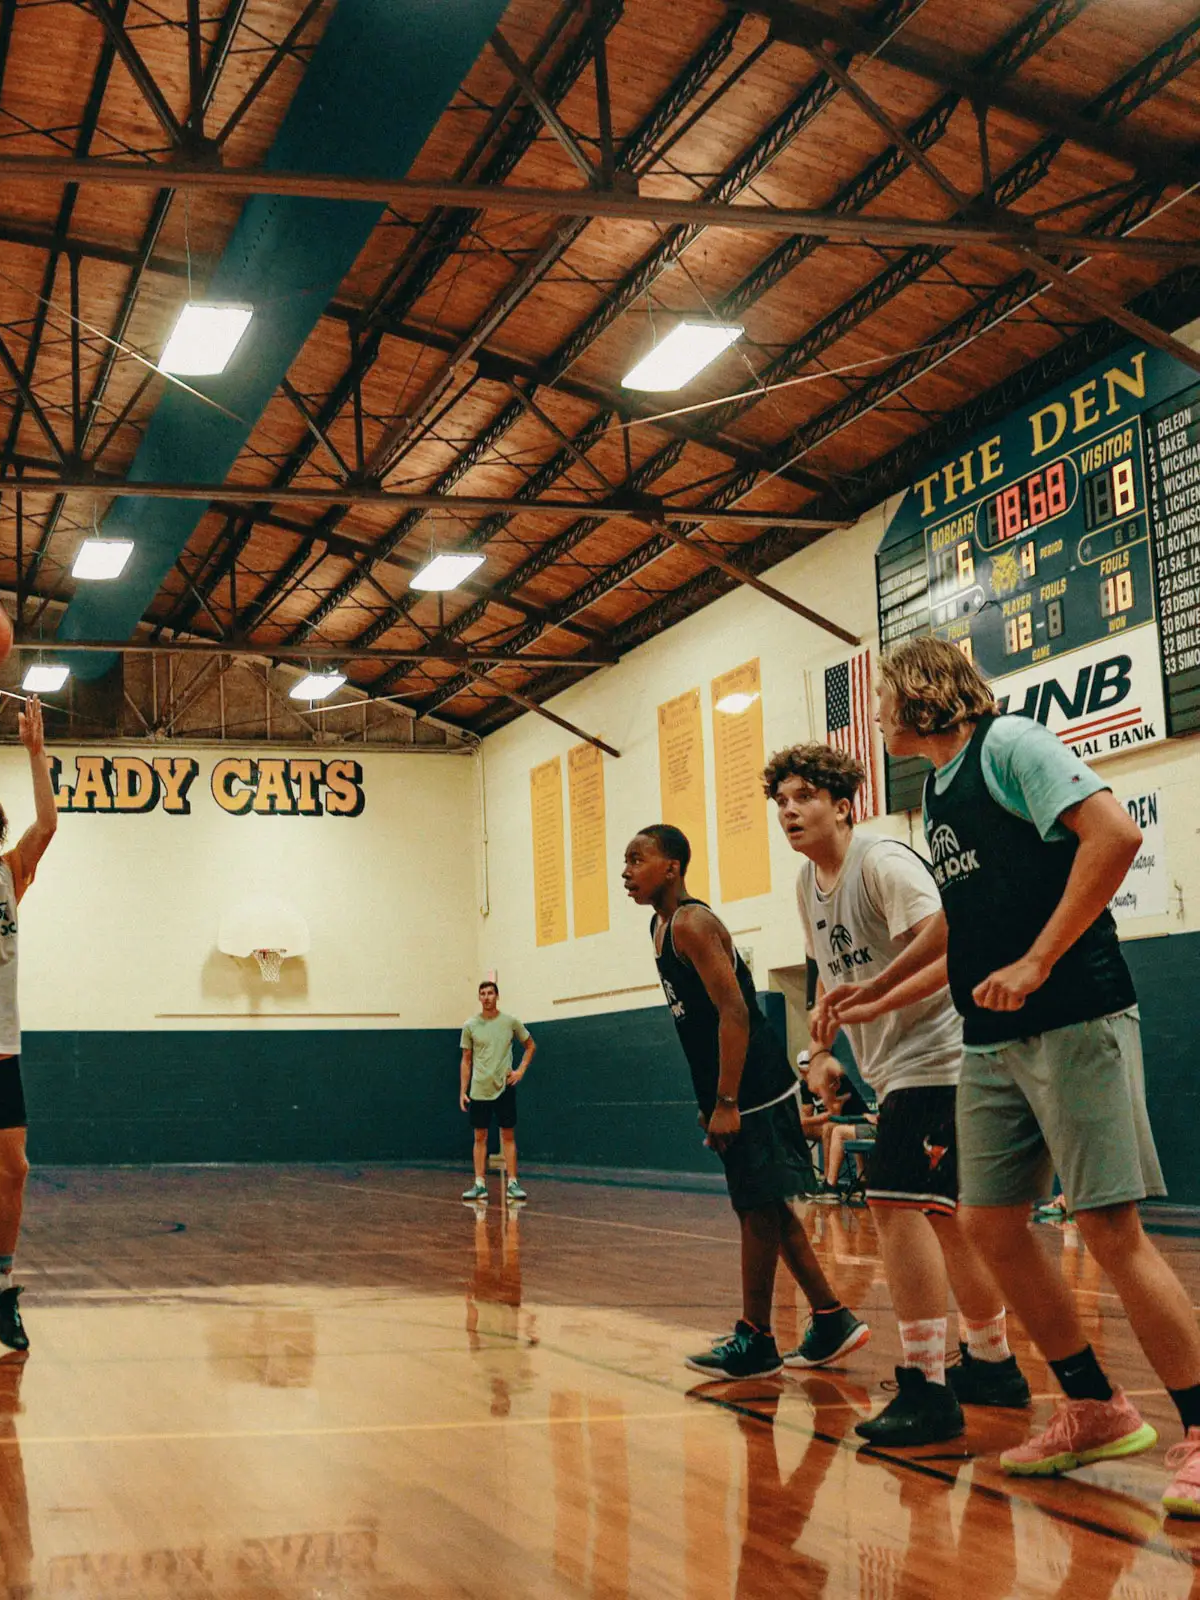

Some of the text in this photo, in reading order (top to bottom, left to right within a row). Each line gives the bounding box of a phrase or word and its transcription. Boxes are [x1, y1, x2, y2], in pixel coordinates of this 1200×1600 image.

[913, 352, 1146, 517] THE DEN
[1147, 408, 1192, 443] 1 DELEON
[1081, 428, 1133, 475] VISITOR
[1148, 431, 1188, 463] 2 BAKER
[1150, 466, 1157, 482] 3
[1152, 464, 1200, 501] 4 WICKHA
[1112, 458, 1136, 517] 8
[1153, 504, 1159, 520] 5
[931, 511, 974, 551] BOBCATS
[1155, 521, 1165, 540] 10
[1020, 541, 1036, 576] 4
[1040, 539, 1063, 560] PERIOD
[1156, 541, 1165, 558] 11
[957, 540, 975, 587] 6
[1100, 551, 1129, 576] FOULS
[1158, 561, 1168, 578] 21
[1170, 552, 1187, 573] SAE
[1003, 578, 1067, 617] PLAYER FOULS
[1160, 579, 1171, 598] 22
[1161, 598, 1172, 617] 23
[1109, 615, 1126, 632] WON
[1162, 617, 1174, 636] 30
[1163, 637, 1176, 656] 32
[1165, 656, 1177, 675] 33
[999, 654, 1132, 727] HNB
[1110, 723, 1156, 749] BANK
[47, 755, 366, 818] LADY CATS
[1128, 792, 1157, 828] DEN
[0, 921, 17, 936] OC
[827, 946, 873, 977] TH RCK
